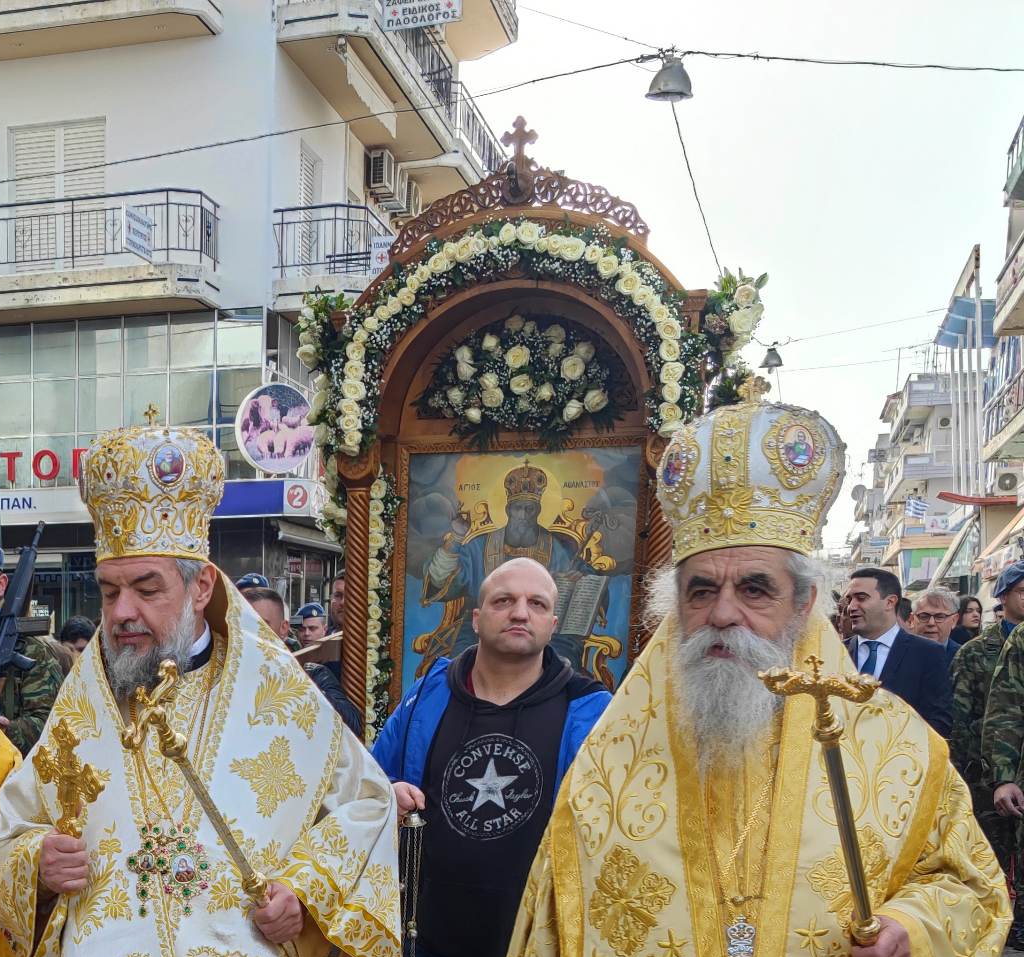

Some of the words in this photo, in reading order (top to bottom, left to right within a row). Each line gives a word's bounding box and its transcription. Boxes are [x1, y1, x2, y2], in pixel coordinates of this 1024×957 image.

[387, 9, 457, 27] ΠΑΘΟΛΟΓΟΣ
[402, 3, 441, 16] ΕΙΔΙΚΟΣ
[453, 743, 532, 778] CONVERSE
[456, 809, 478, 831] ALL
[483, 807, 523, 832] STAR
